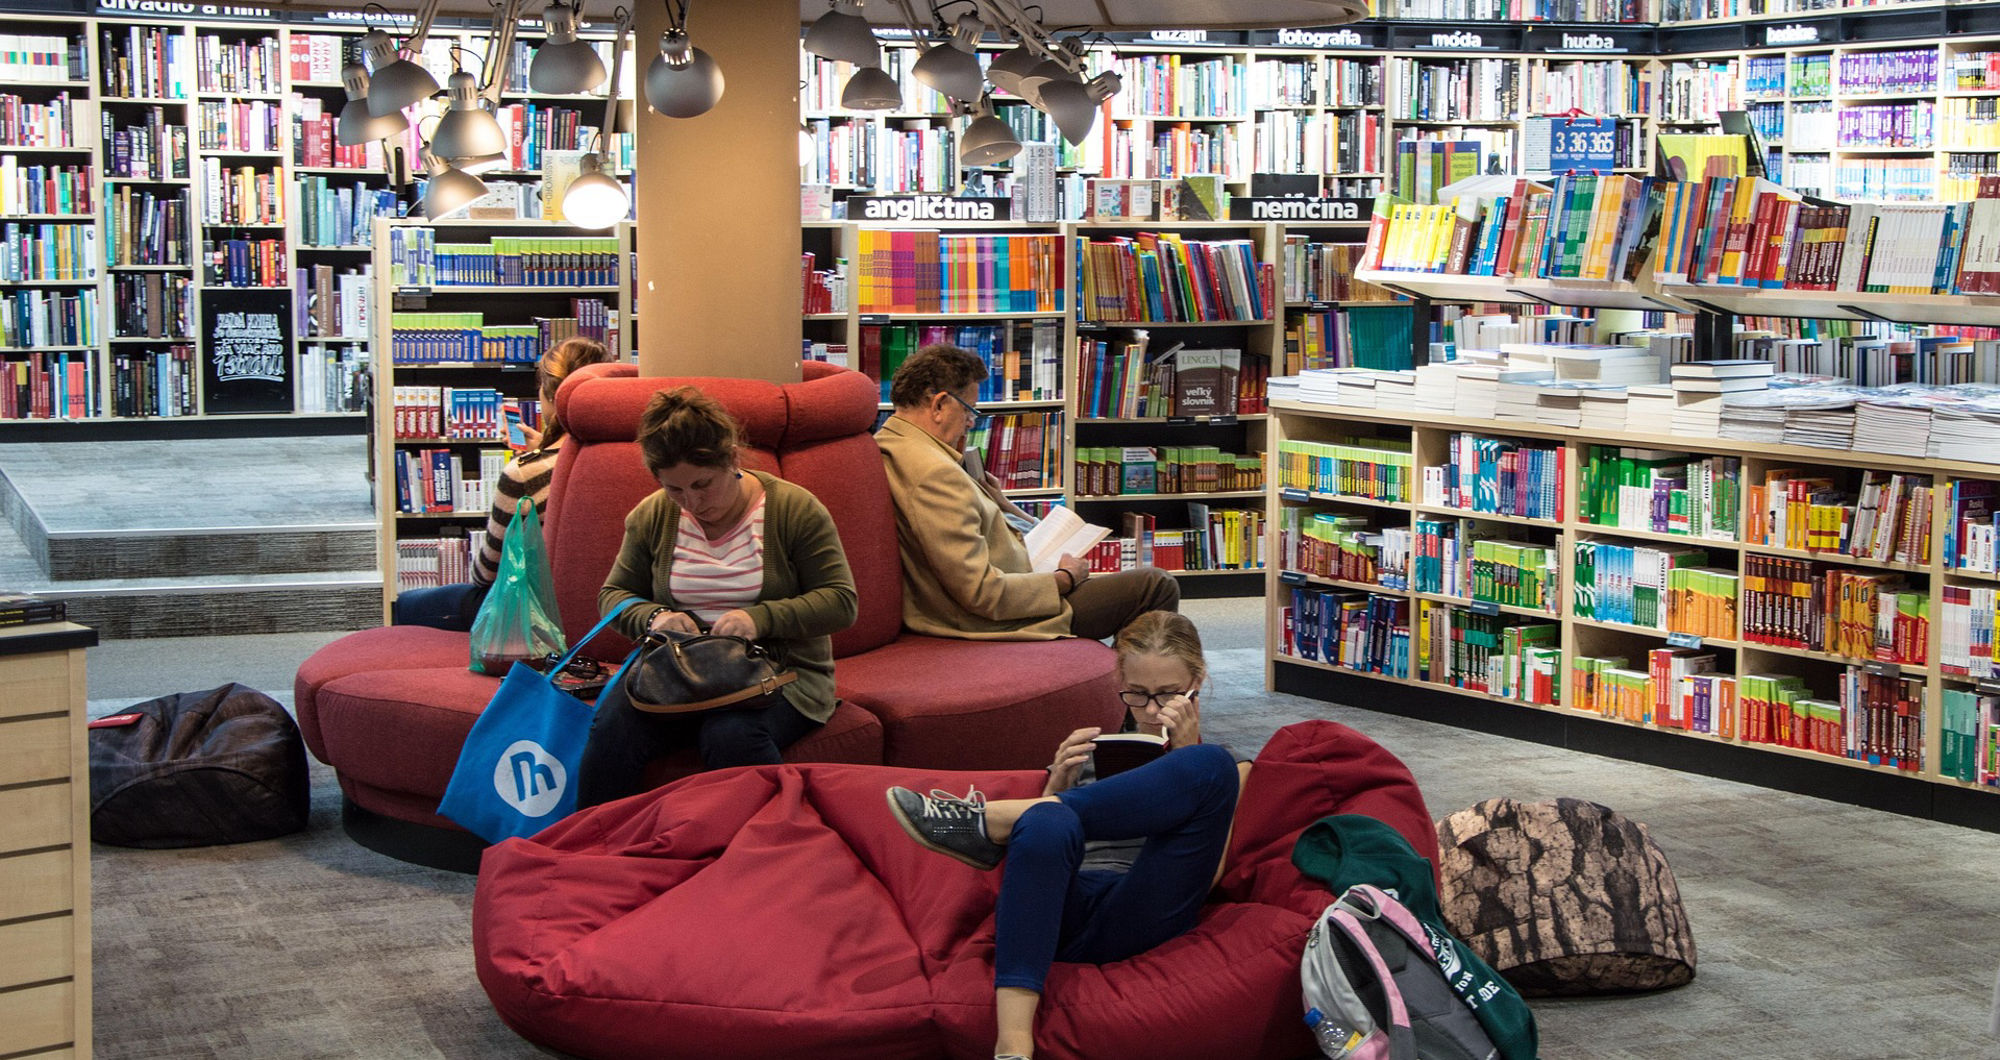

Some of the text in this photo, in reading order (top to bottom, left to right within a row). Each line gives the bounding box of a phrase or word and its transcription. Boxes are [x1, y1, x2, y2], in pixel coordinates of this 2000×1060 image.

[1278, 28, 1361, 48] fotografia
[1432, 31, 1482, 48] móda
[1562, 33, 1615, 49] hudba
[1556, 131, 1614, 153] 3 36 365
[864, 196, 995, 221] angličtina
[1252, 196, 1359, 220] nemčina
[233, 344, 261, 355] VIAC
[1182, 355, 1218, 365] LINGEA
[1185, 387, 1212, 398] veľký
[1182, 397, 1215, 406] slovník
